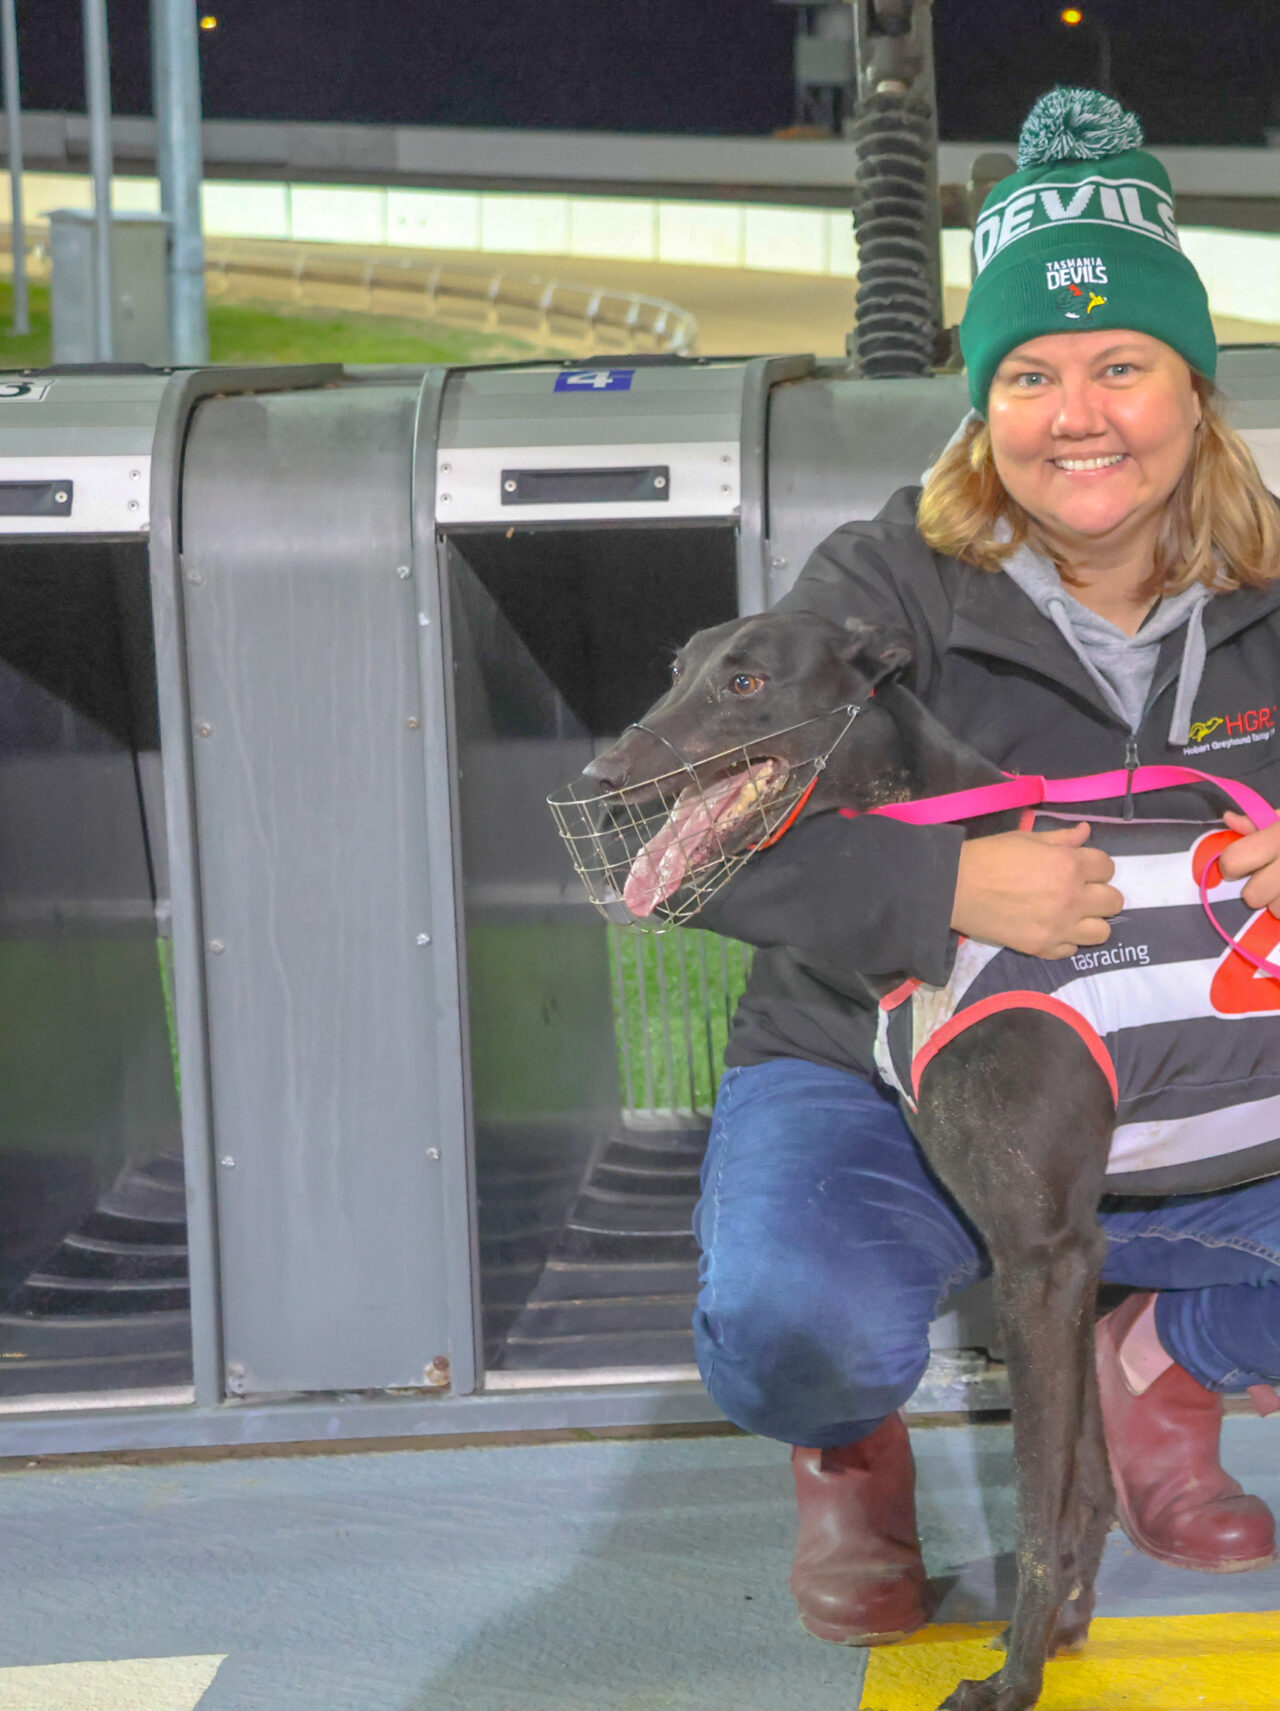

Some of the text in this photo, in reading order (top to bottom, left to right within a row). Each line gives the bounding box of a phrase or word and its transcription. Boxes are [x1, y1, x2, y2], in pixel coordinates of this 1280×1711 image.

[974, 184, 1181, 275] DEVILS
[1046, 257, 1103, 272] TASMANIA
[1046, 265, 1108, 290] DEVILS
[566, 371, 613, 388] 4
[1070, 942, 1150, 971] tasracing
